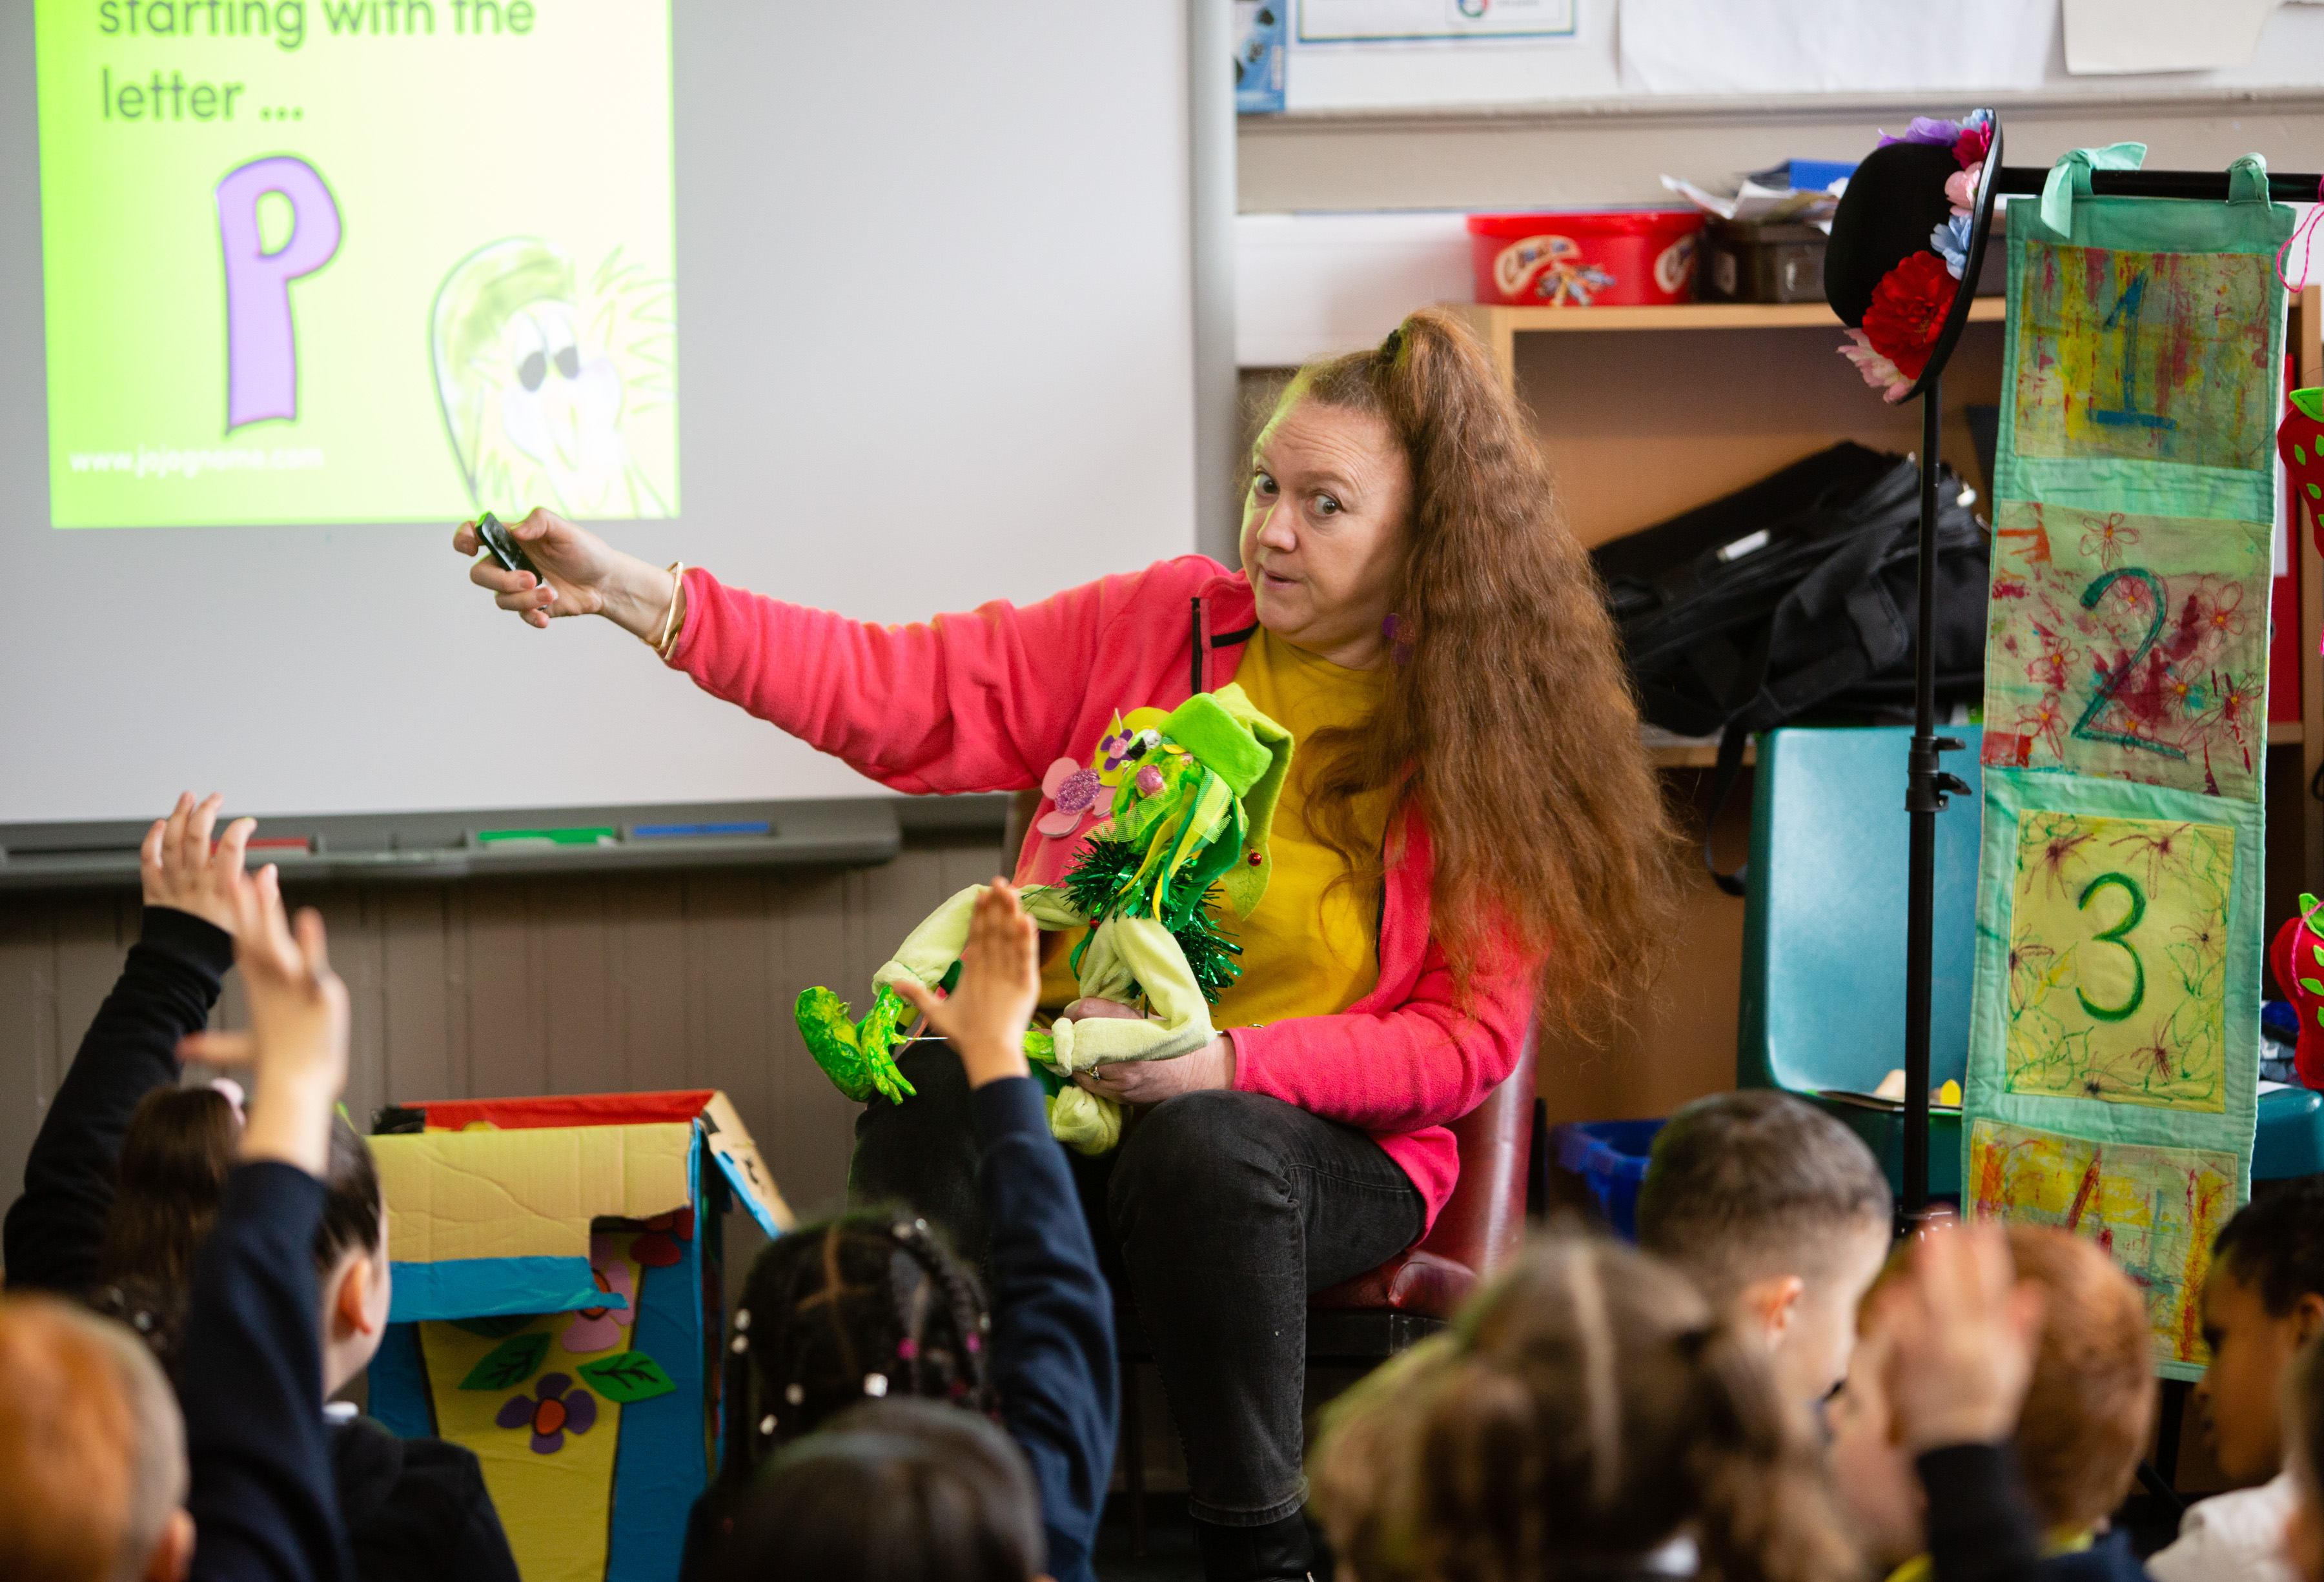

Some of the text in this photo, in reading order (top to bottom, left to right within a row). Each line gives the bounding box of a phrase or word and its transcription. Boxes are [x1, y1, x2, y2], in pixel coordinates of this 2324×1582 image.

[98, 0, 535, 49] starting with the
[101, 66, 243, 120] letter
[2086, 268, 2179, 431] 1
[2071, 567, 2188, 762] 2
[2075, 871, 2146, 1021] 3
